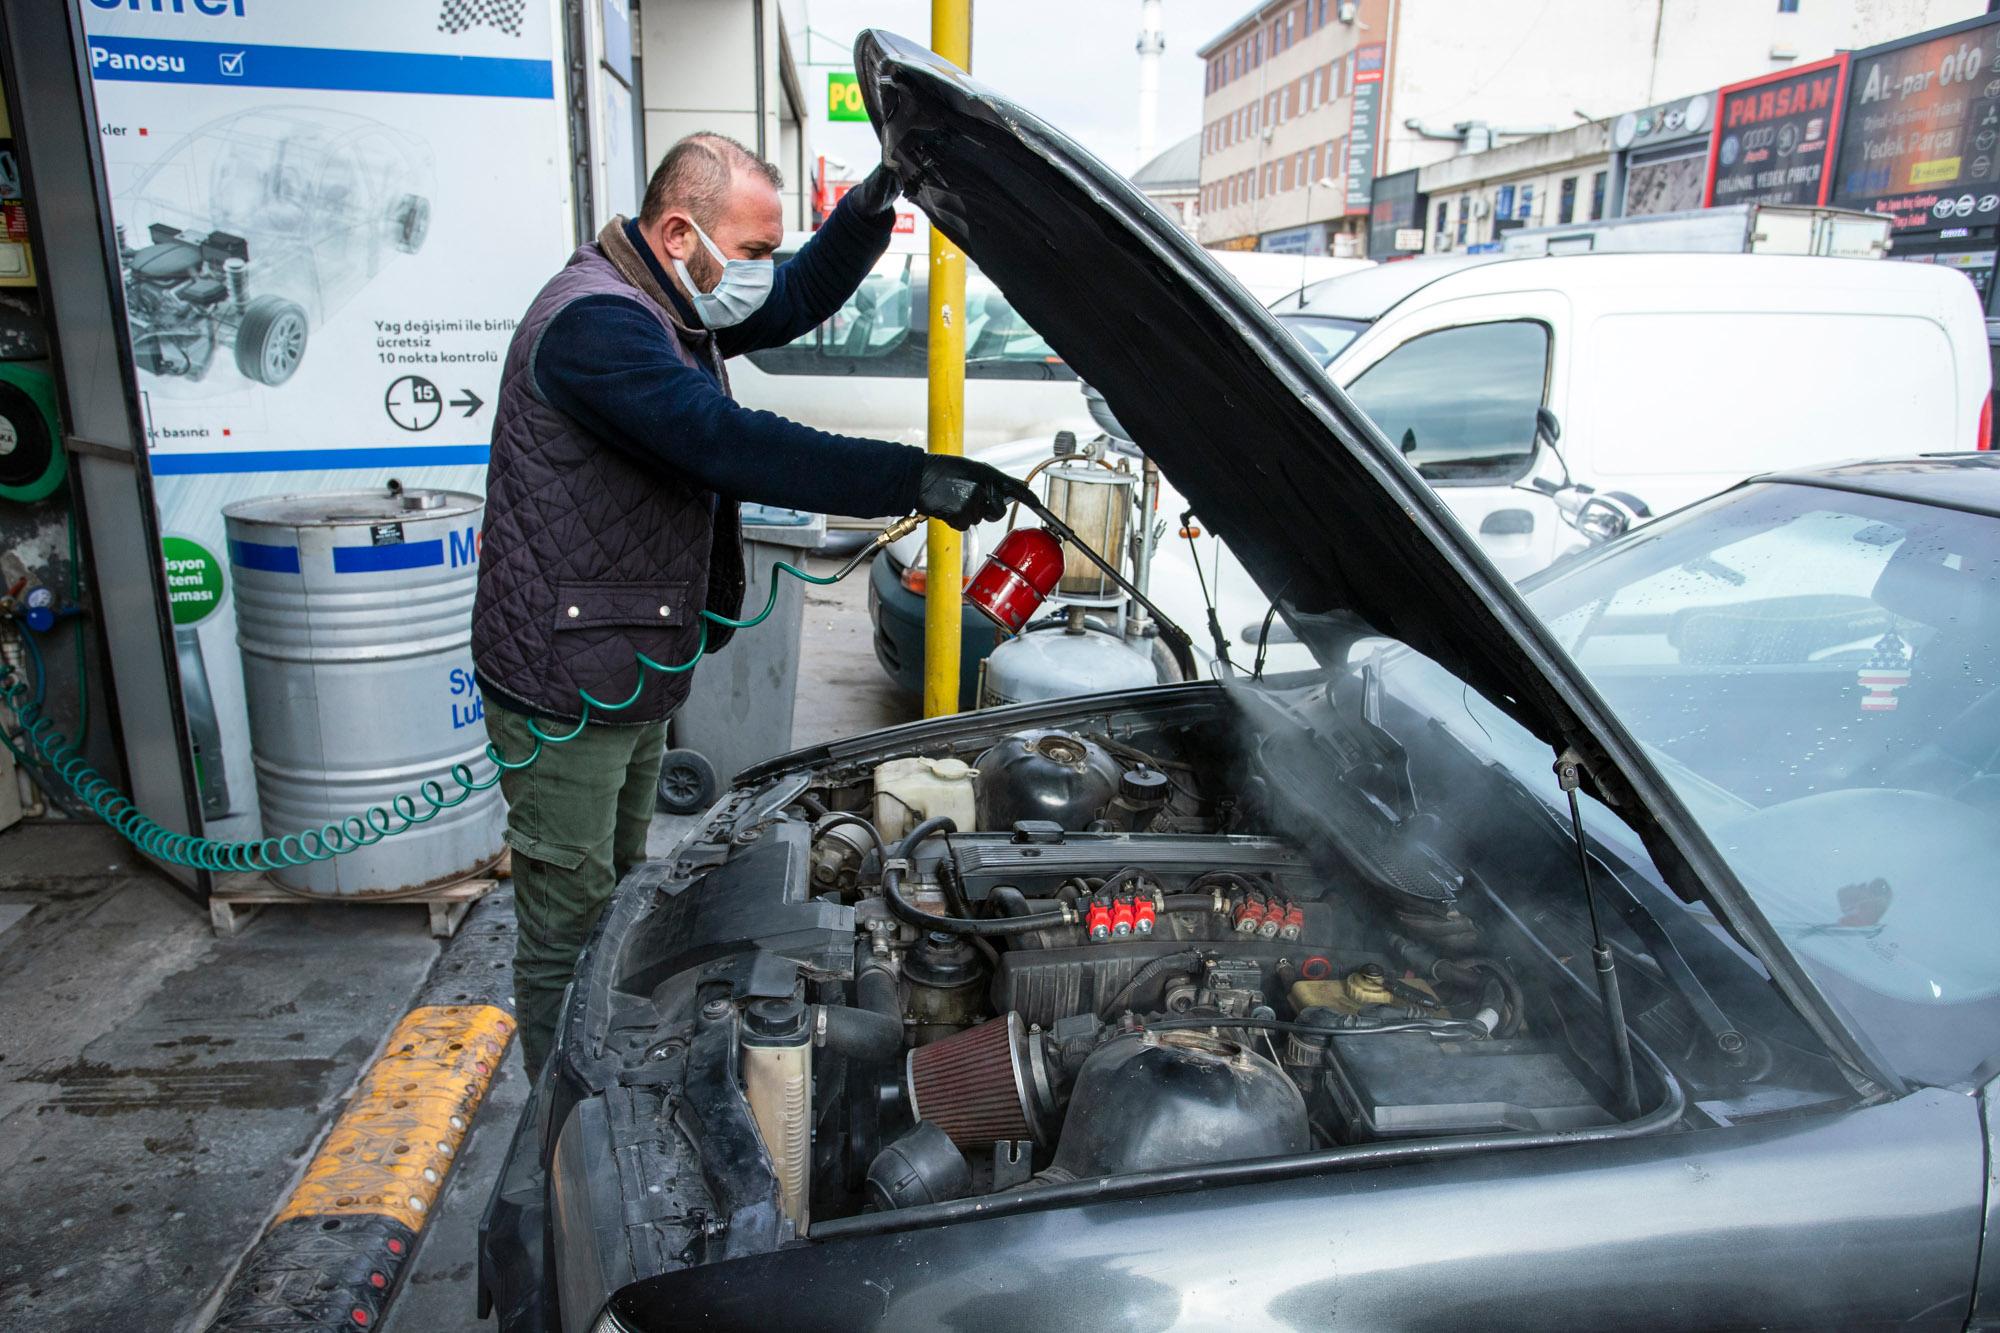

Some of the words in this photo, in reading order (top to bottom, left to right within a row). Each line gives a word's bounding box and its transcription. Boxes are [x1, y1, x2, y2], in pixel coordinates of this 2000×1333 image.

[91, 47, 185, 73] Panosu
[830, 82, 866, 112] PO
[1728, 78, 1832, 128] PARSAN
[404, 320, 463, 334] değişimi
[465, 320, 481, 331] ile
[376, 336, 431, 348] ücretsiz
[379, 353, 395, 363] 10
[398, 352, 438, 363] nokta
[440, 351, 498, 363] kontrolü
[414, 385, 434, 400] 15
[162, 427, 209, 438] basıncı
[168, 571, 204, 586] temi
[169, 590, 214, 602] uması
